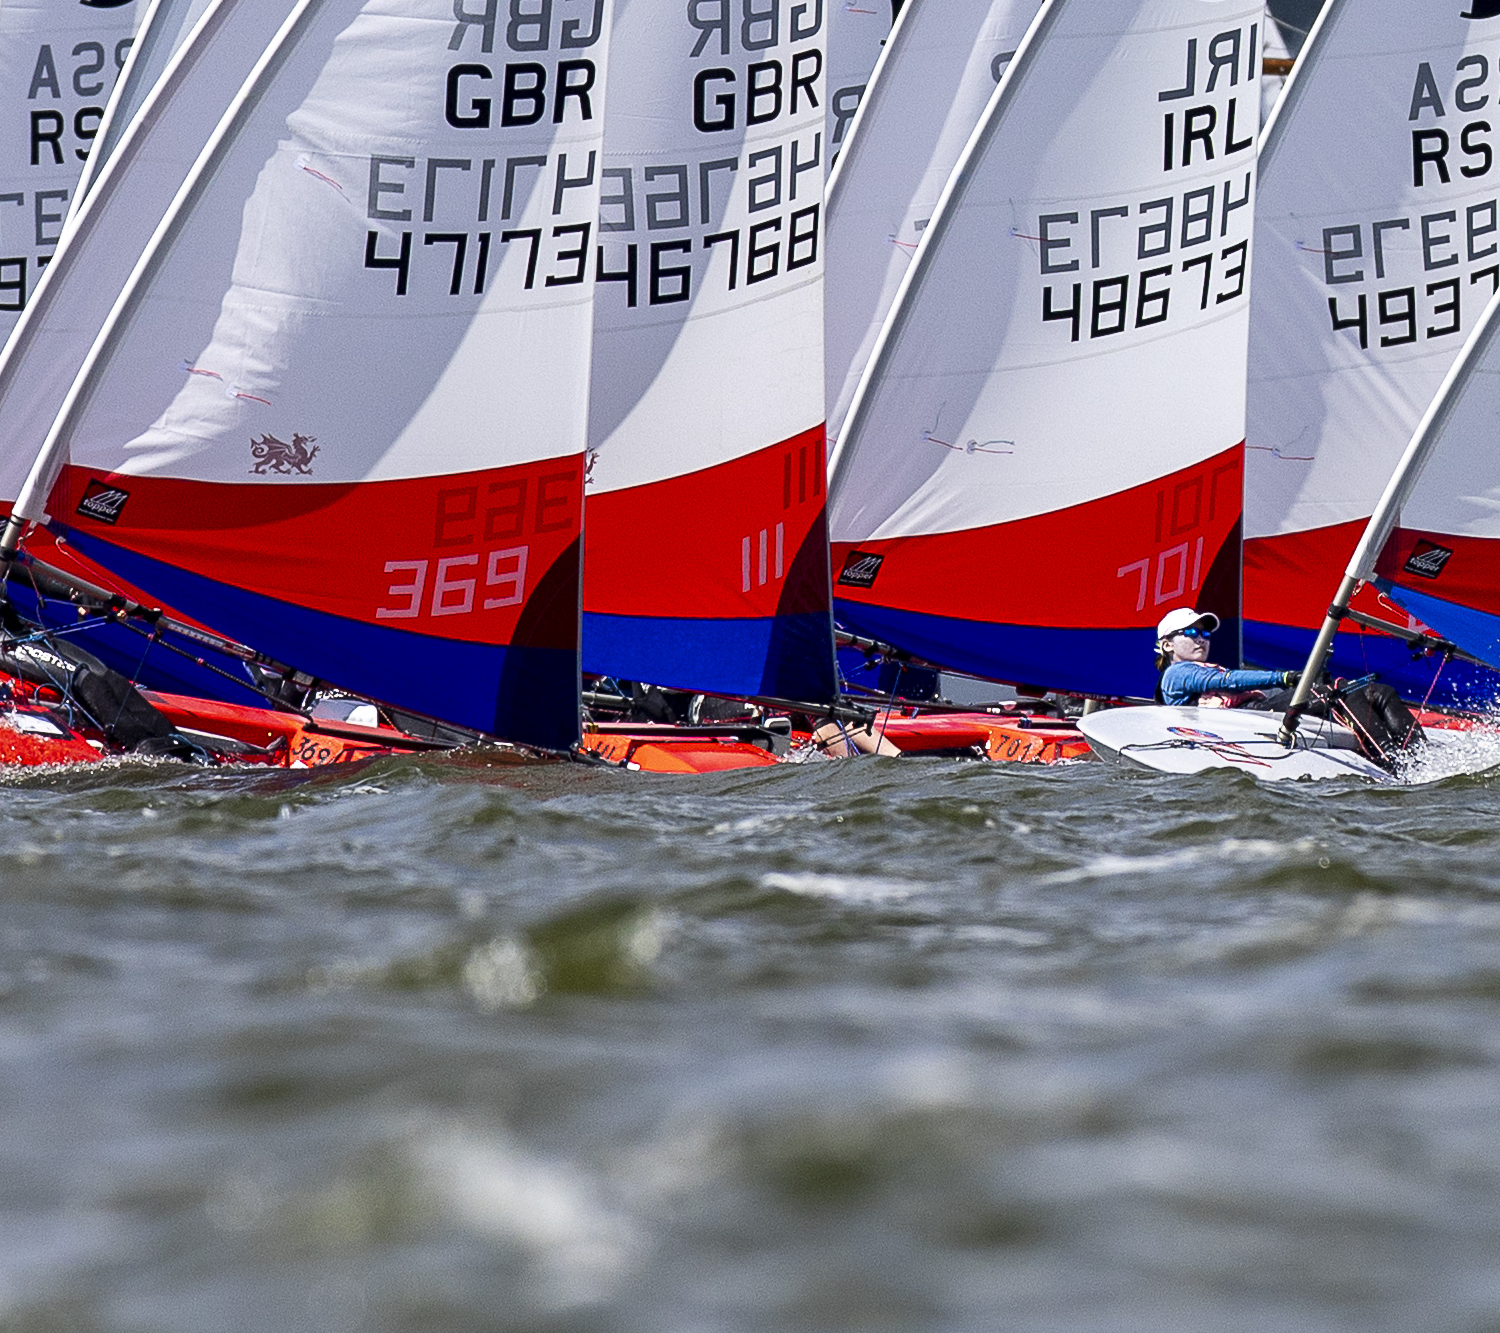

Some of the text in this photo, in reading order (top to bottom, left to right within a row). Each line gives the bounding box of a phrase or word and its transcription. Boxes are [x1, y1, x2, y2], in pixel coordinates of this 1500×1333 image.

[445, 58, 596, 129] GBR
[693, 48, 823, 133] GBR
[30, 106, 105, 165] RS
[1163, 97, 1253, 172] IRL
[364, 221, 592, 297] 47173
[596, 202, 821, 308] 46768
[1042, 238, 1248, 343] 48673
[83, 497, 117, 516] topper
[375, 545, 529, 619] 369
[843, 568, 874, 580] topper
[1117, 536, 1203, 612] 701
[1409, 556, 1440, 572] topper
[995, 734, 1033, 762] 701
